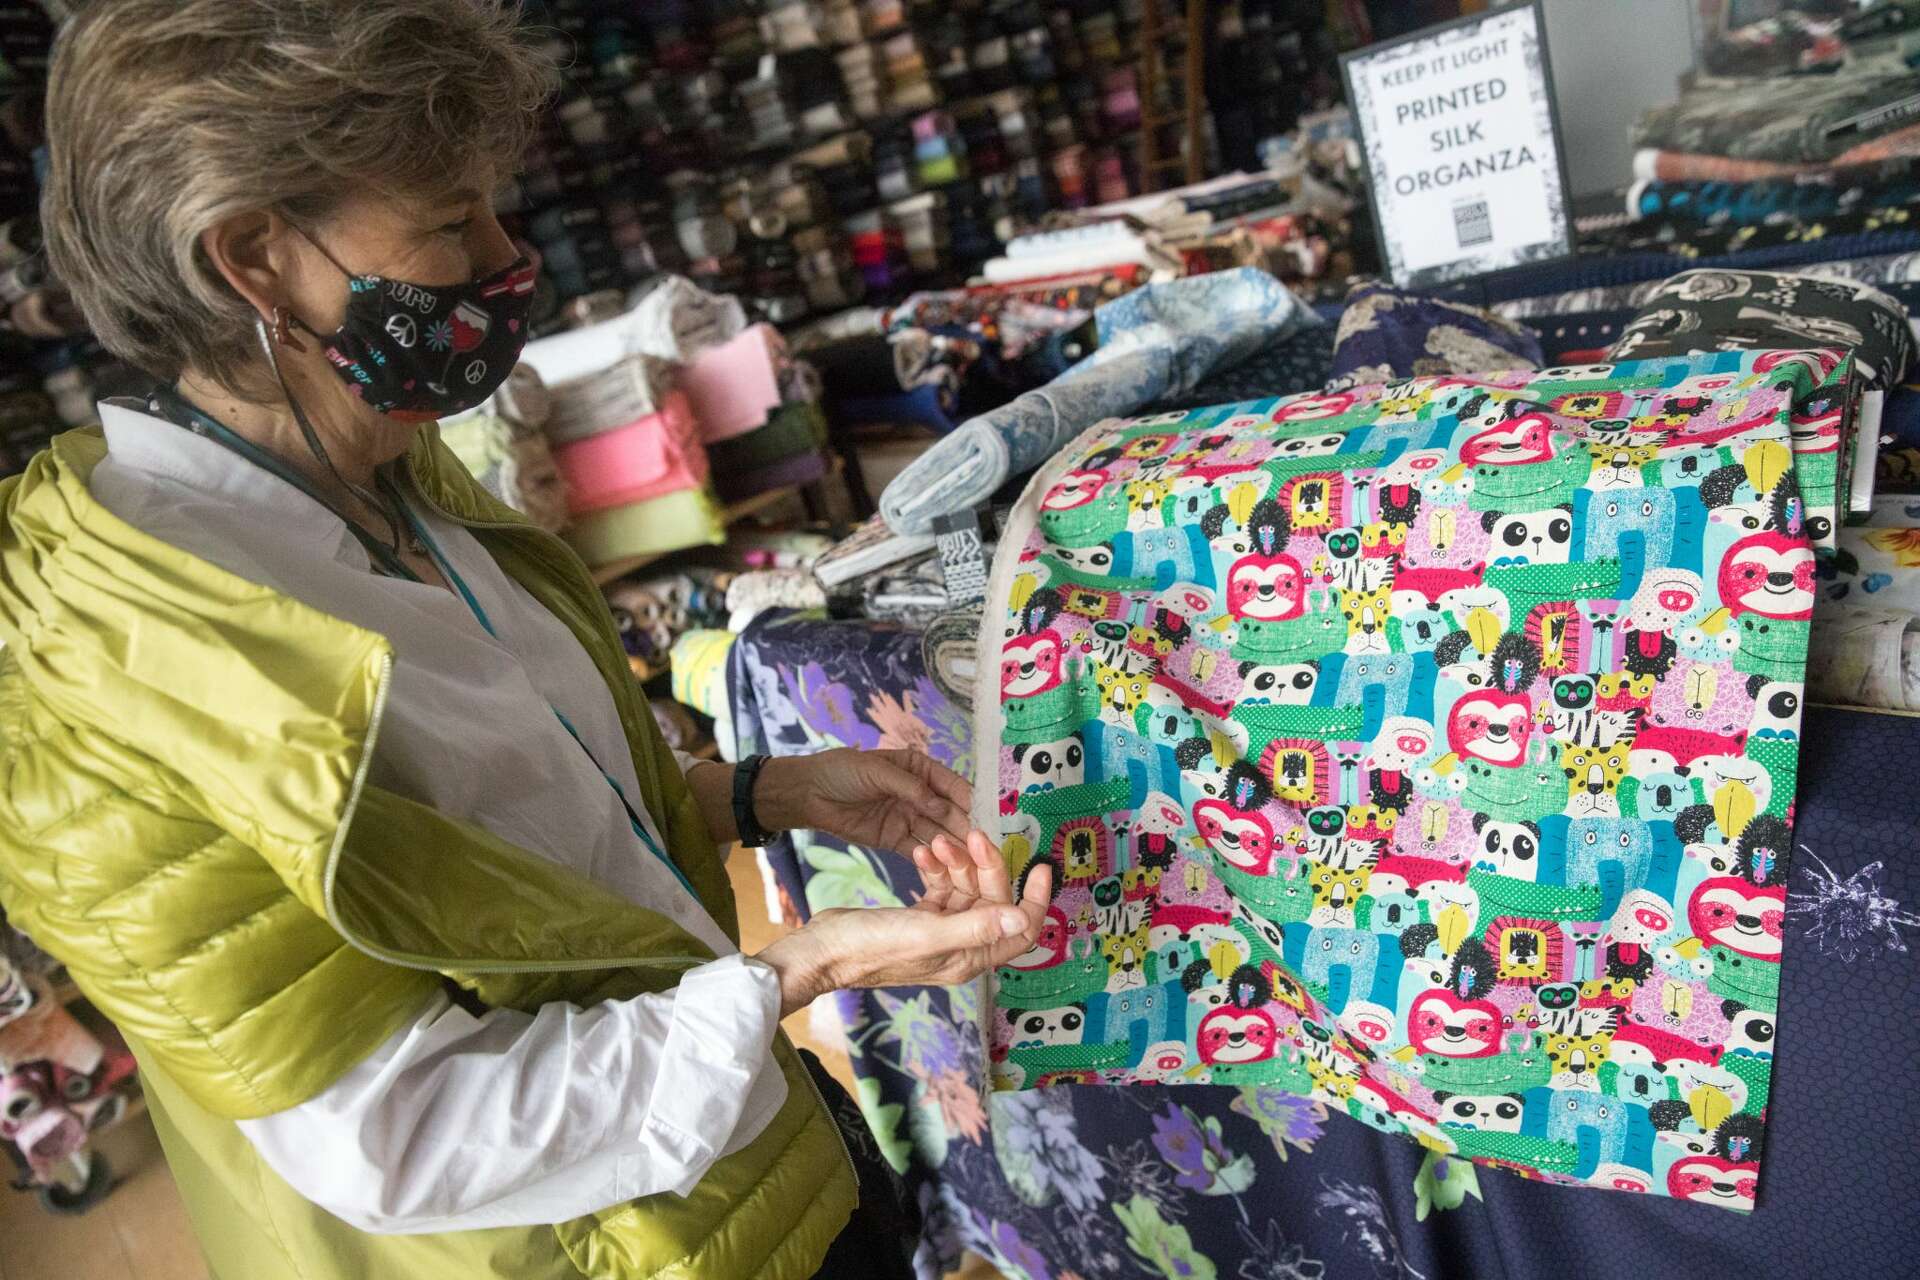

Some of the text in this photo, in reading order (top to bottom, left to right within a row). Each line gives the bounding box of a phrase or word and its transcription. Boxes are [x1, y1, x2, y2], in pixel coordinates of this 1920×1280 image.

[1381, 39, 1509, 89] KEEP IT LIGHT
[1396, 78, 1507, 124] PRINTED
[1430, 121, 1484, 152] SILK
[1395, 147, 1536, 196] ORGANZA
